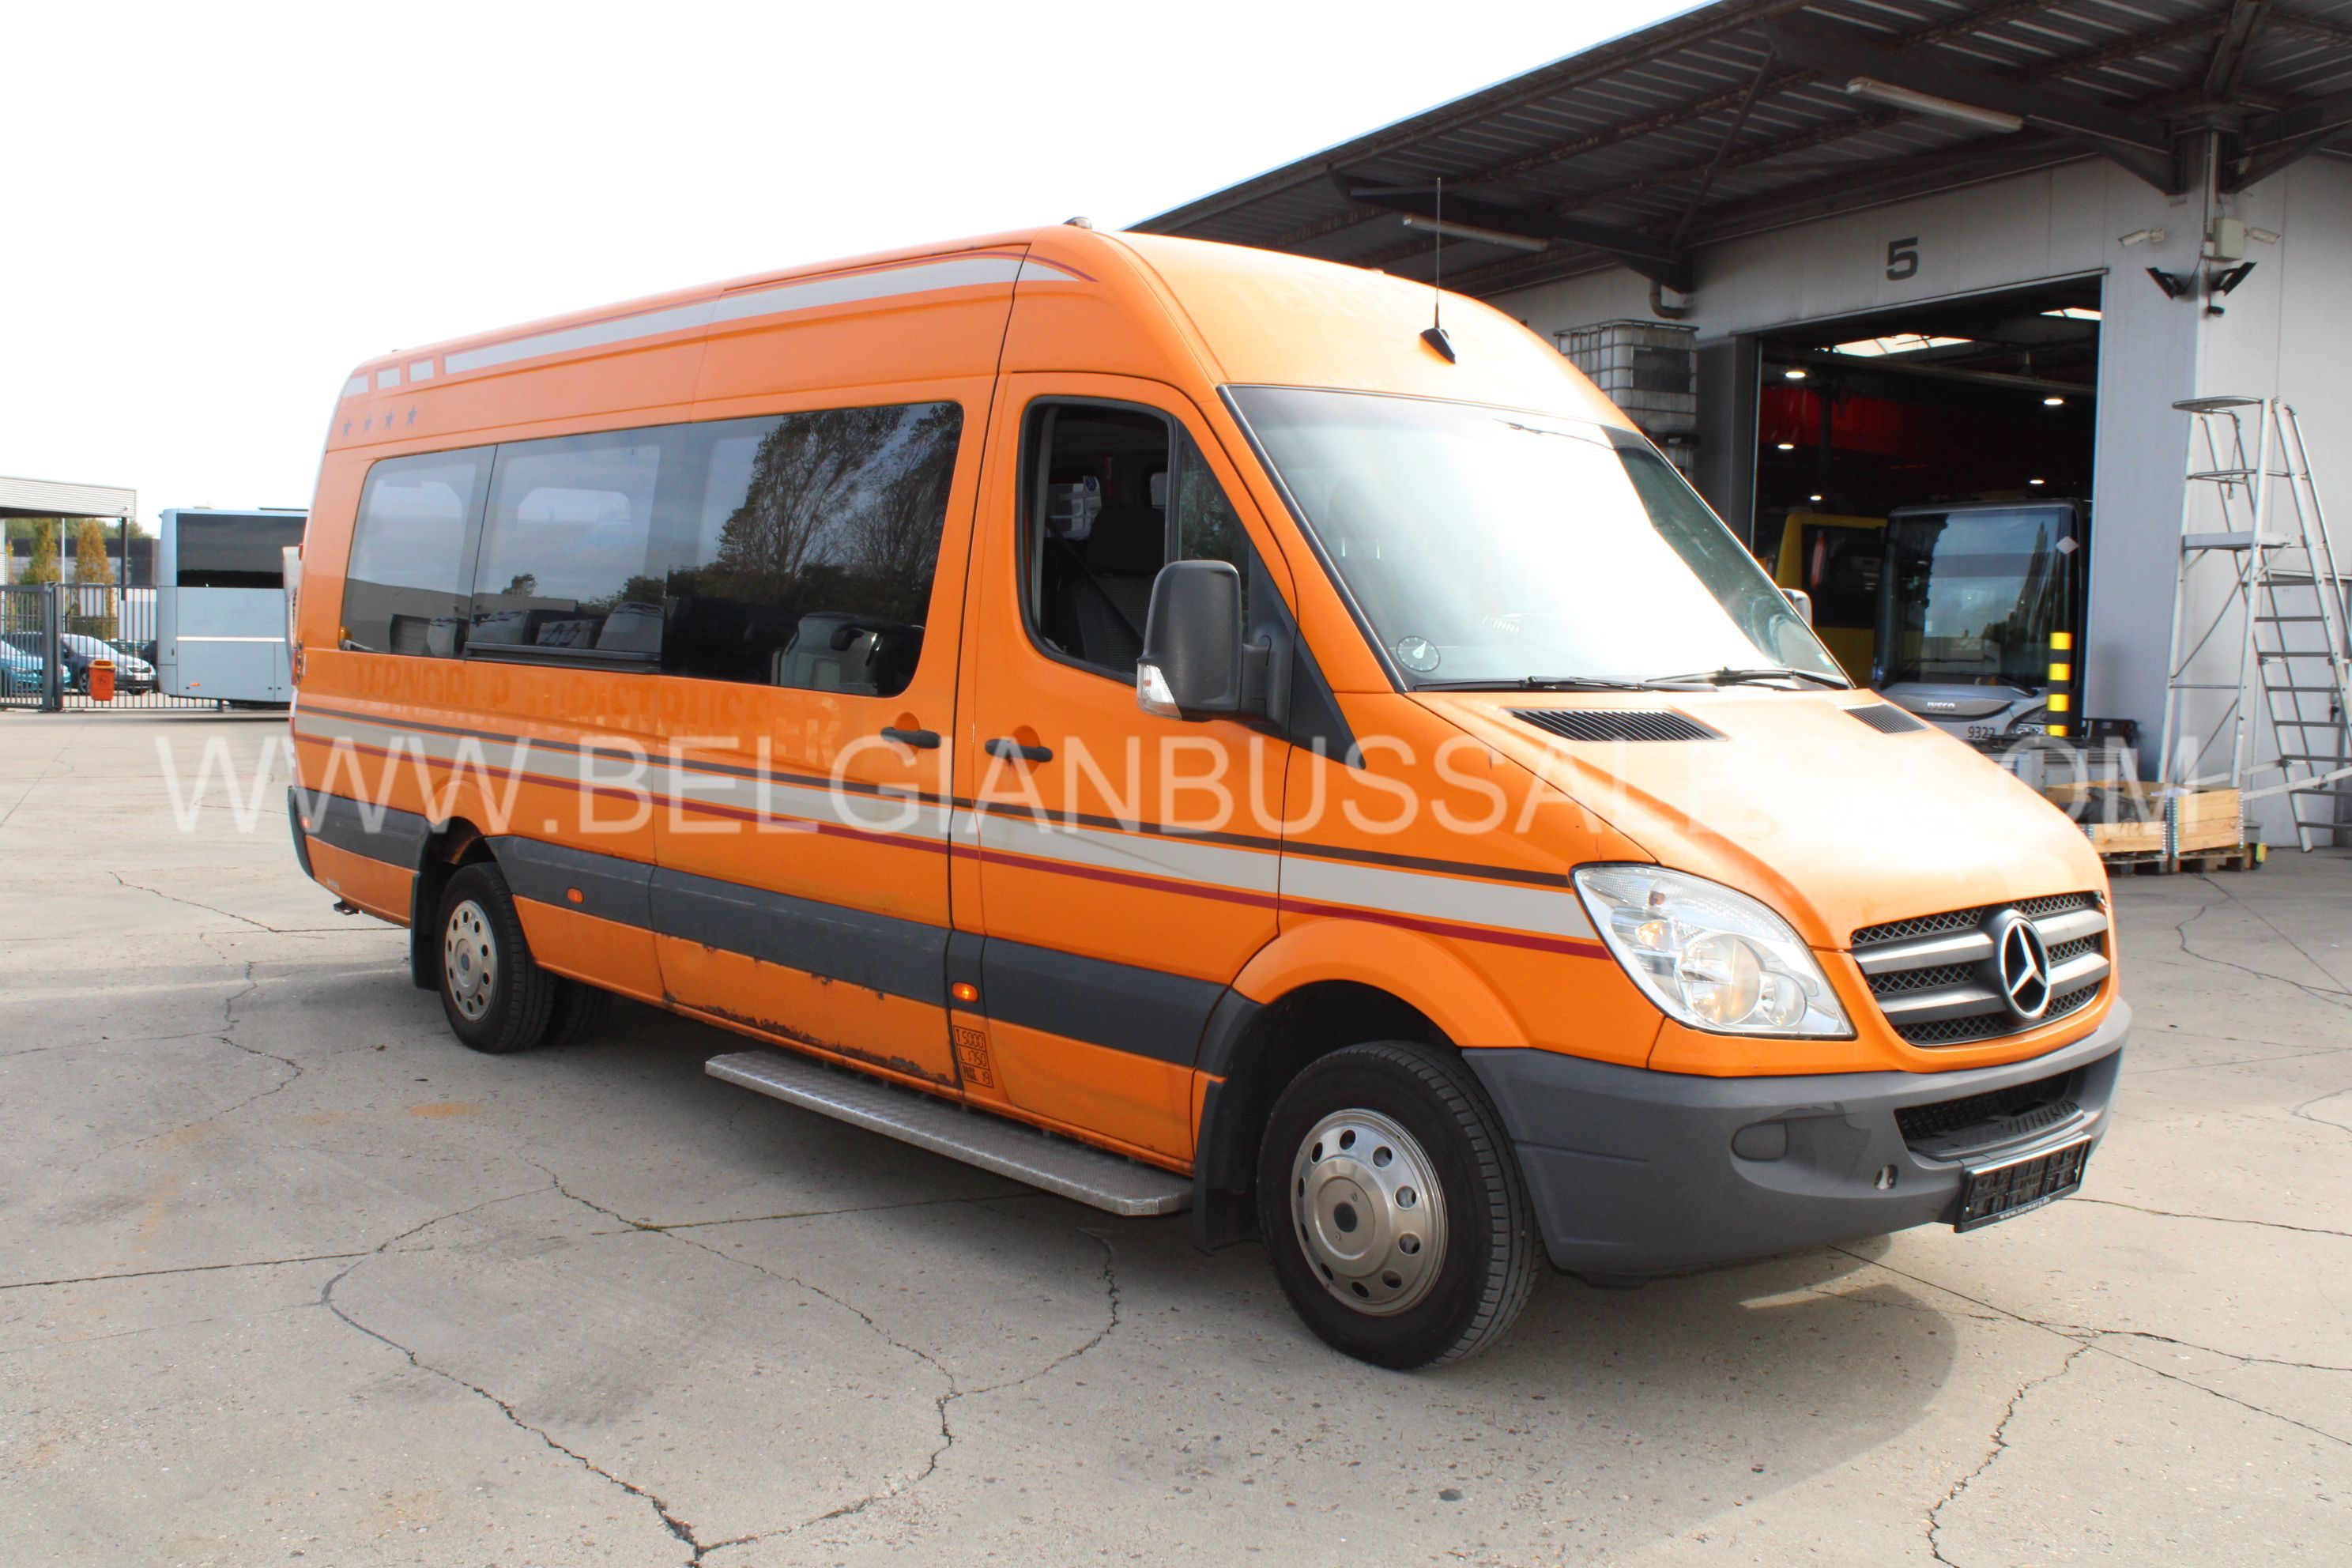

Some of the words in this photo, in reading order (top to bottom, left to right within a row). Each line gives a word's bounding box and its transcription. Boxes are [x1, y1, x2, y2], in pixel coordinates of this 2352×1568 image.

[1886, 236, 1919, 281] 5
[956, 1028, 961, 1042] T
[962, 1031, 984, 1049] 5000
[959, 1046, 965, 1061] L
